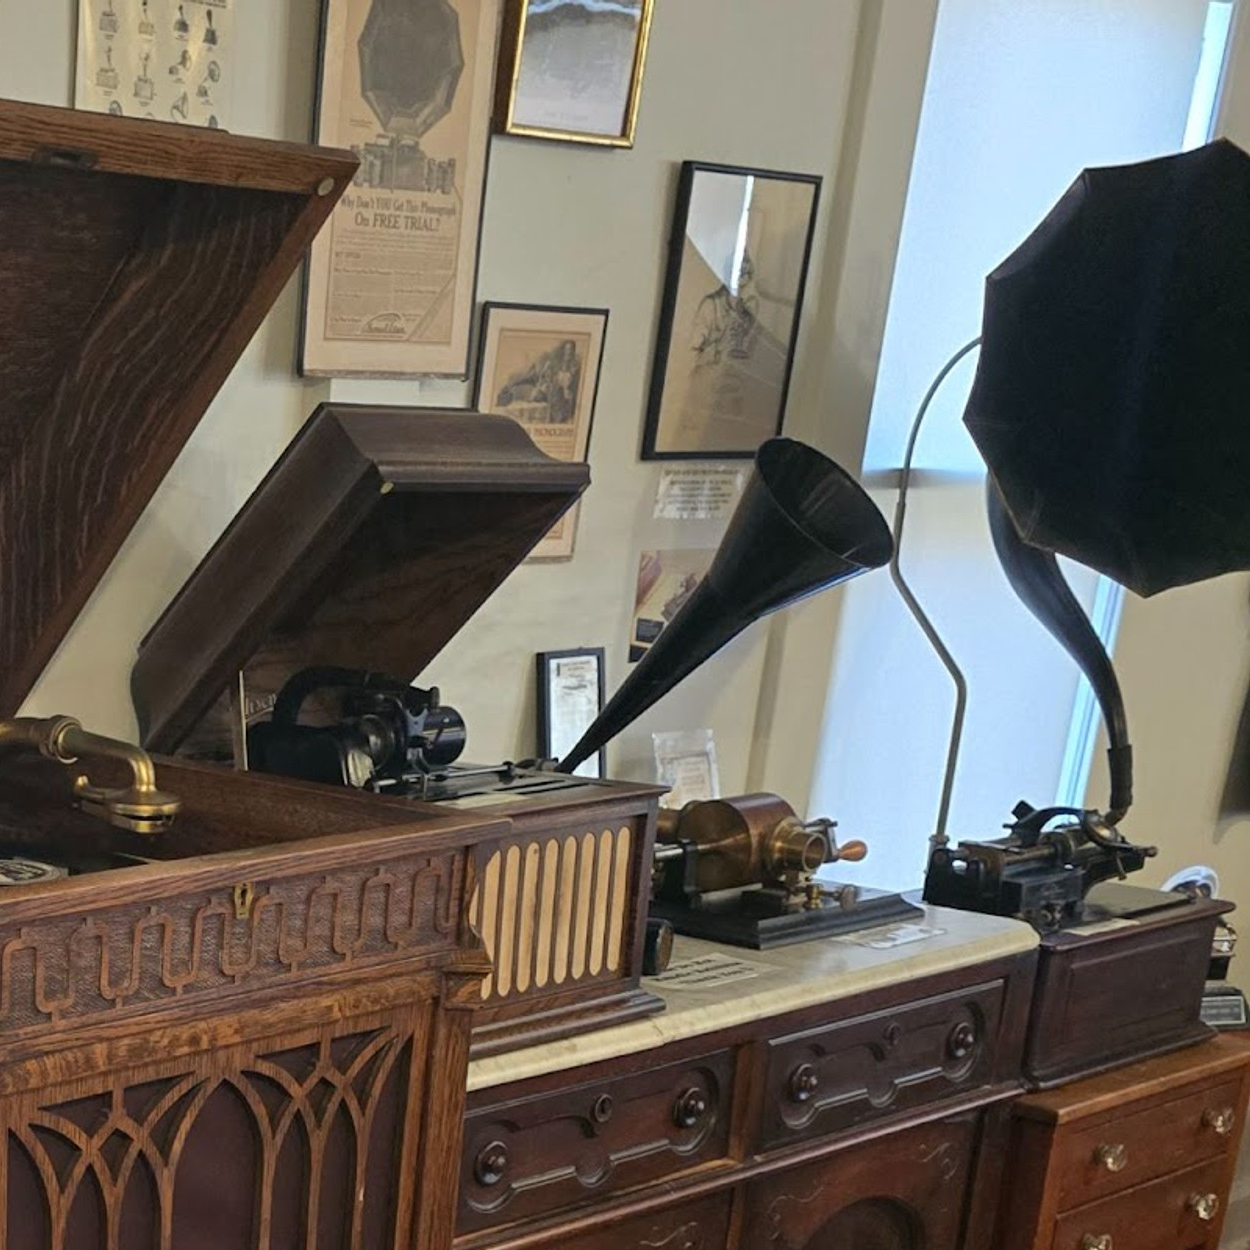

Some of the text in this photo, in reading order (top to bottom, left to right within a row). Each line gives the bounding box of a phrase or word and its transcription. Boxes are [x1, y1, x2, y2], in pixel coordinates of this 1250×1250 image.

[354, 211, 441, 232] On FREE TRIAL?
